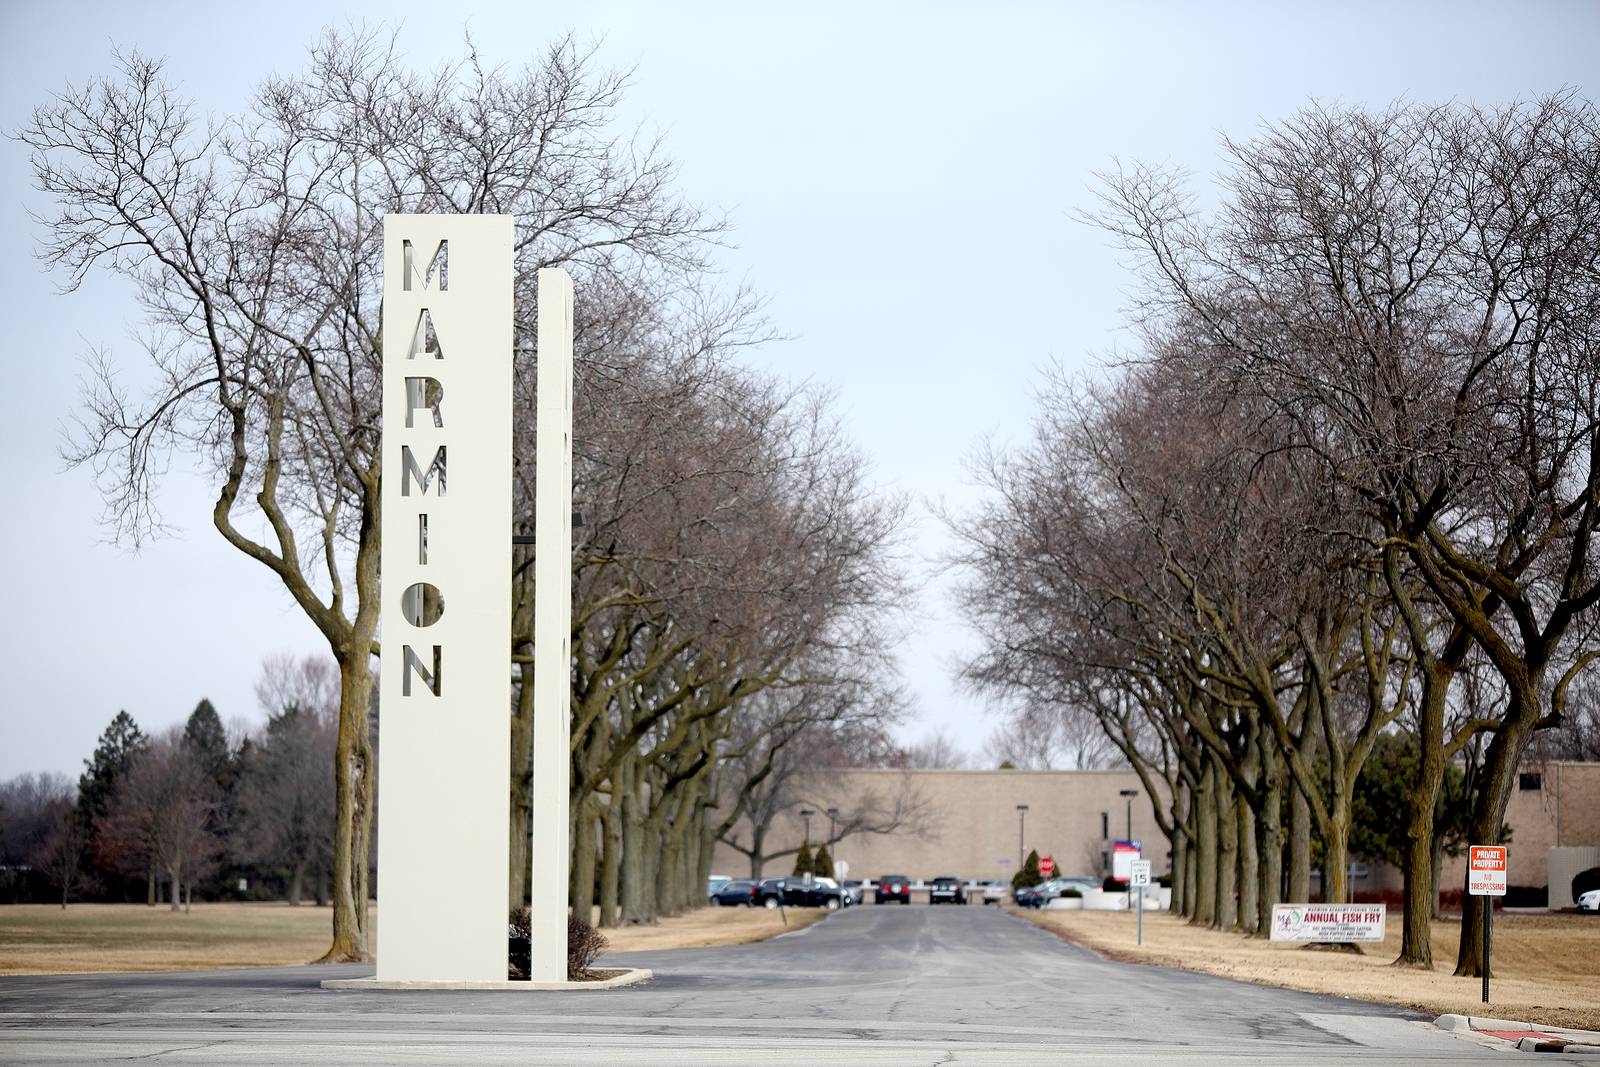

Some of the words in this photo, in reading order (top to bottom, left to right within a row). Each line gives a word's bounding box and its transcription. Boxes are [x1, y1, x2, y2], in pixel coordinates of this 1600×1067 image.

[401, 239, 448, 697] MARMION
[1476, 850, 1501, 859] PRIVATE
[1040, 861, 1055, 869] STOP
[1473, 859, 1504, 868] PROPERTY
[1135, 874, 1147, 884] 15
[1484, 873, 1492, 881] NO
[1471, 882, 1505, 891] TRESPASSING
[1303, 912, 1339, 923] ANNUAL
[1342, 912, 1362, 923] FISH
[1364, 912, 1382, 923] FRY
